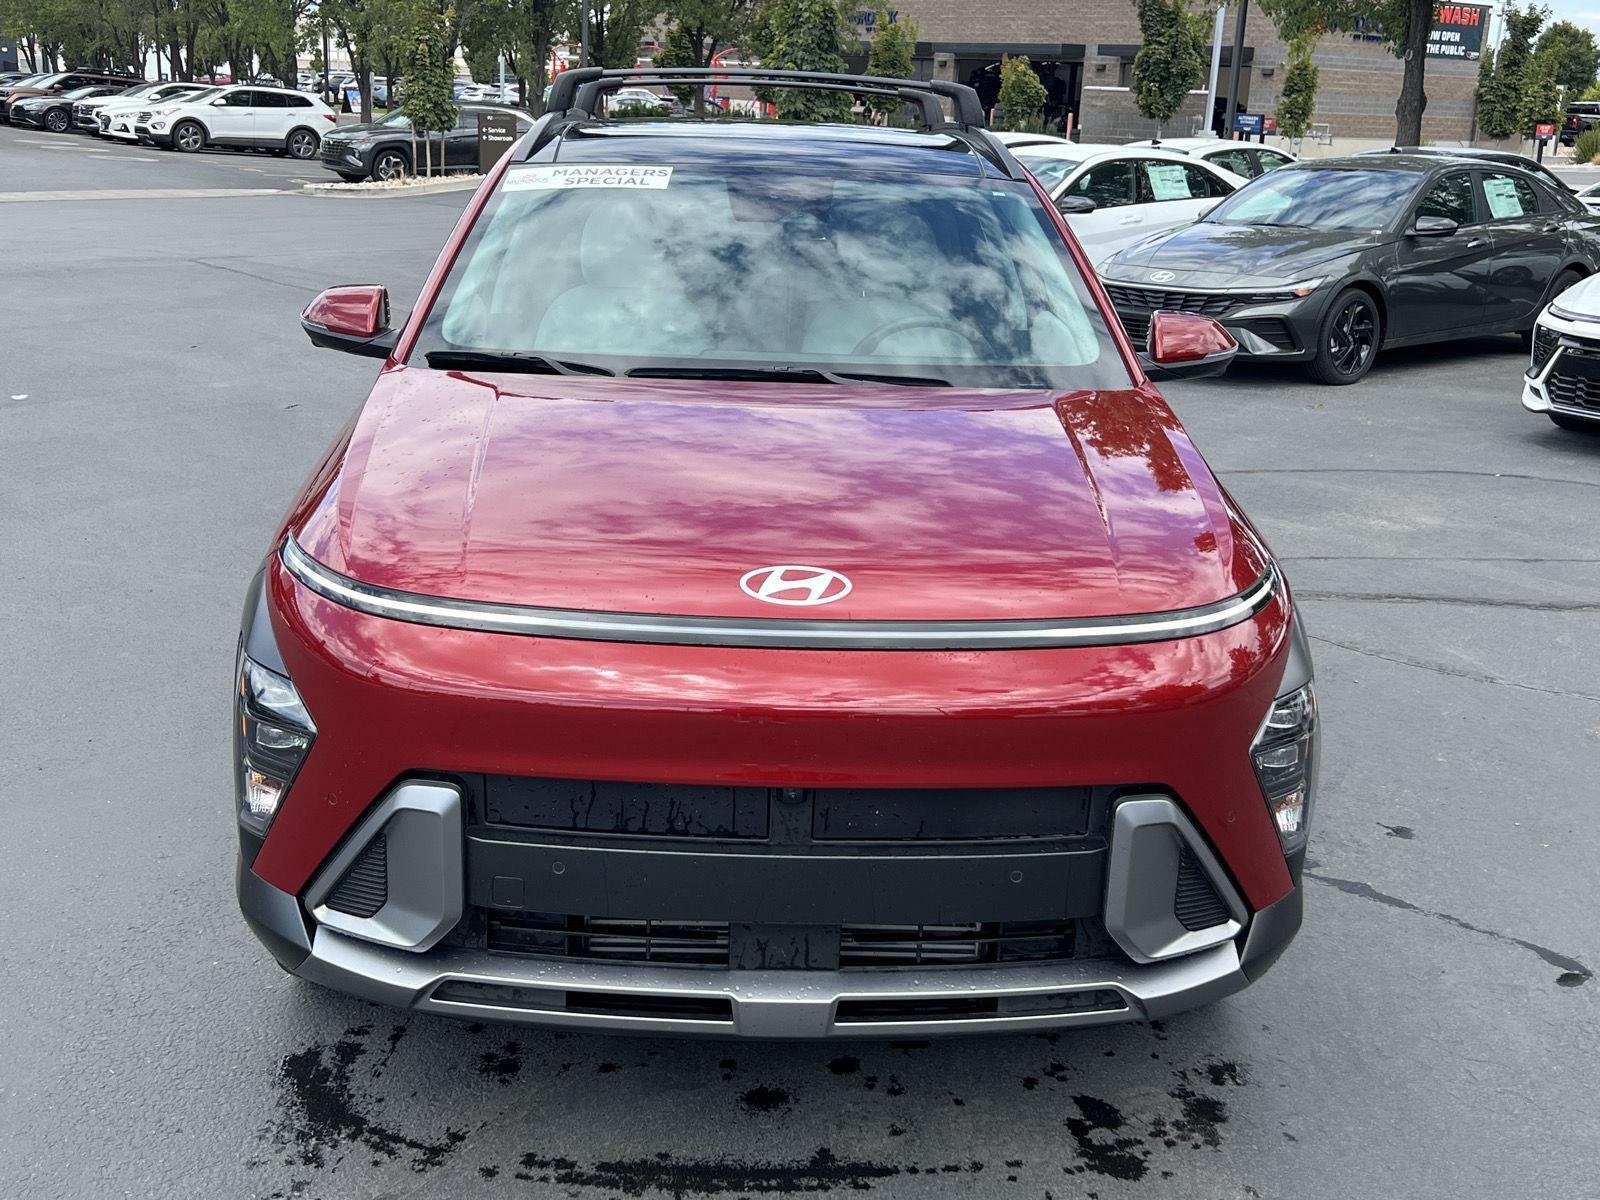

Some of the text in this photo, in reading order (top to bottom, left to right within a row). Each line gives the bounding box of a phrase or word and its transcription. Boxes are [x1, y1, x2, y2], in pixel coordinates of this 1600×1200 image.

[1440, 5, 1480, 26] WASH
[1441, 31, 1460, 42] OPEN
[1426, 43, 1440, 54] THE
[1440, 44, 1466, 56] PUBLIC
[552, 168, 668, 178] MANAGERS
[564, 177, 650, 186] SPECIAL
